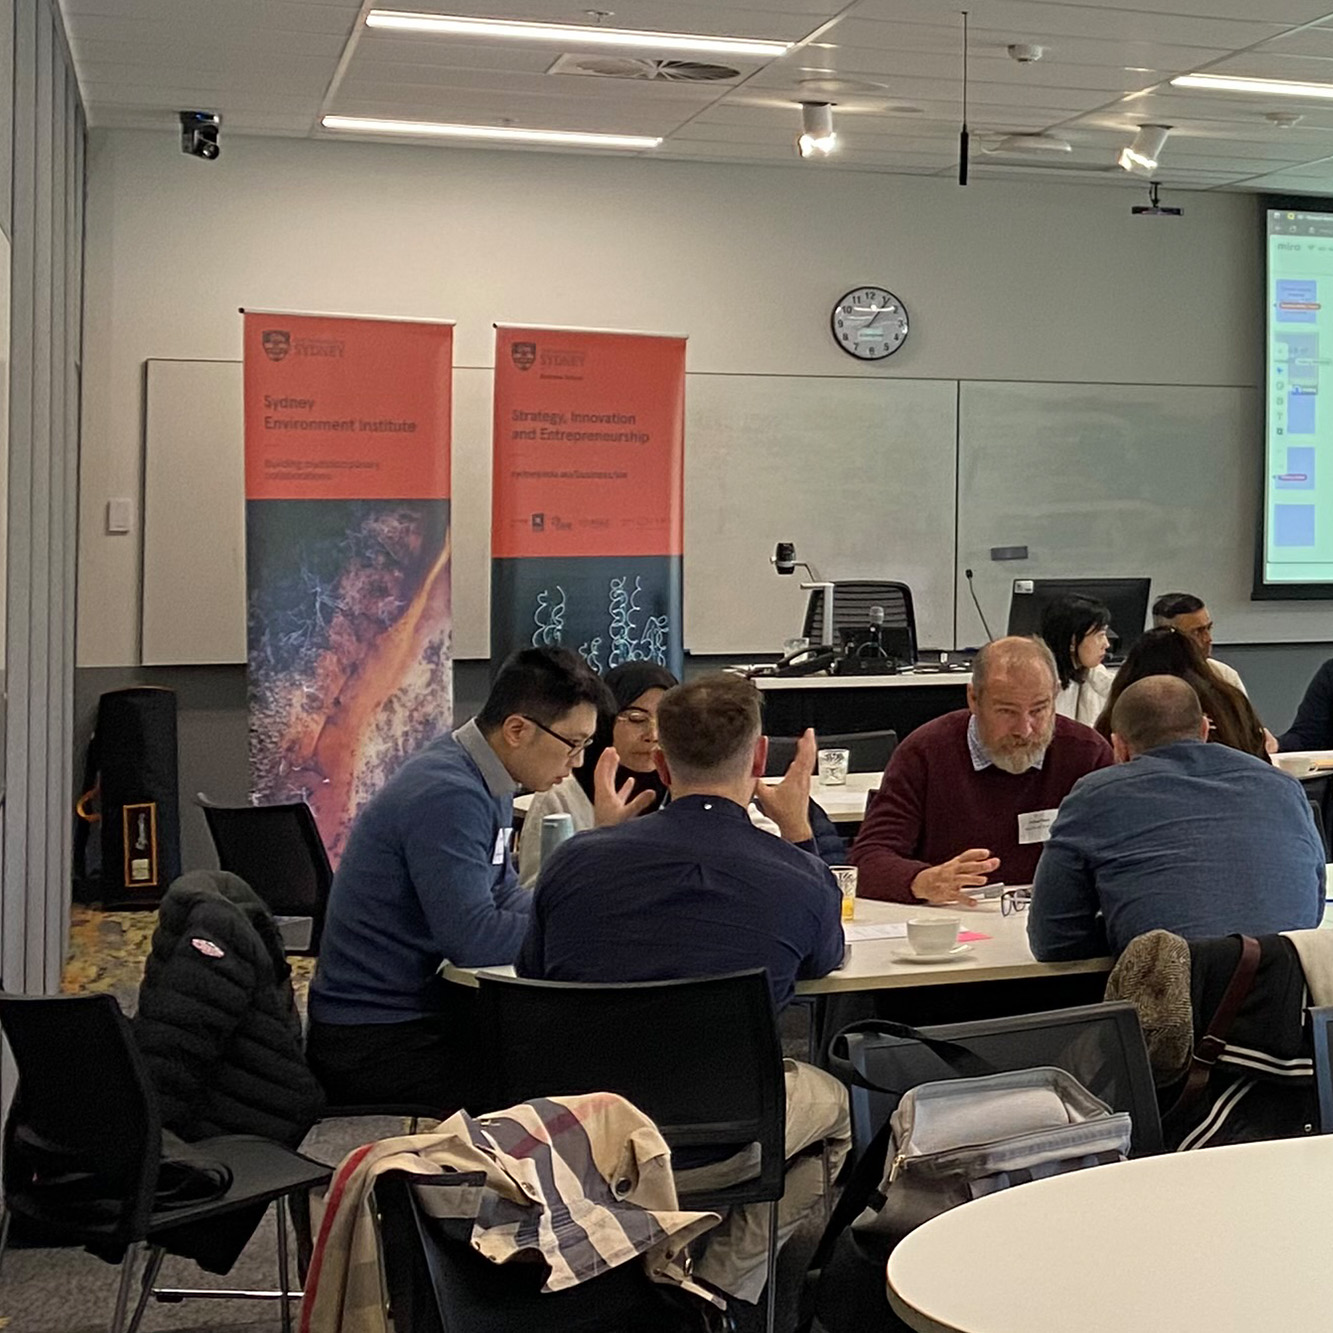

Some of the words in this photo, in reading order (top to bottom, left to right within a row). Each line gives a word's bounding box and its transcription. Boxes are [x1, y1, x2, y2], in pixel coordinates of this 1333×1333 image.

[852, 295, 861, 304] 11
[865, 291, 876, 300] 12
[842, 305, 853, 314] 10
[838, 319, 844, 328] 9
[898, 319, 904, 328] 3
[842, 332, 849, 341] 8
[894, 333, 899, 341] 4
[295, 342, 345, 357] SYDNEY
[853, 342, 859, 351] 7
[868, 346, 875, 355] 6
[884, 342, 890, 351] 5
[264, 395, 315, 412] Sydney
[512, 409, 567, 426] Strategy,
[571, 411, 636, 425] Innovation
[264, 416, 355, 432] Environment
[359, 418, 416, 433] Institute
[512, 429, 536, 441] and
[540, 428, 650, 445] Entrepreneurship
